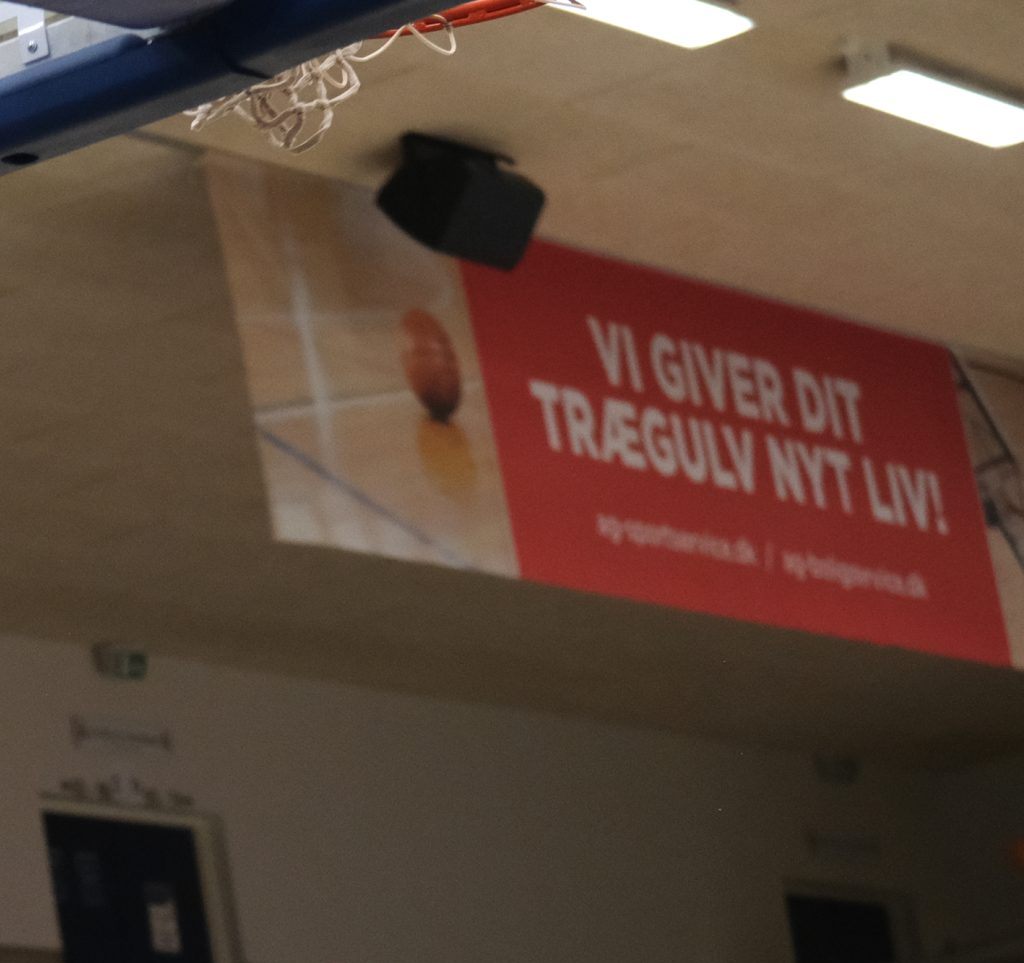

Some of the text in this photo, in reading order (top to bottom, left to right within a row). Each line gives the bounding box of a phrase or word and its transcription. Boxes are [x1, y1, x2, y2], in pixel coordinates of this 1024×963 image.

[587, 315, 862, 443] VI GIVER DIT
[528, 379, 949, 536] TRÆGULV NYT LIV!
